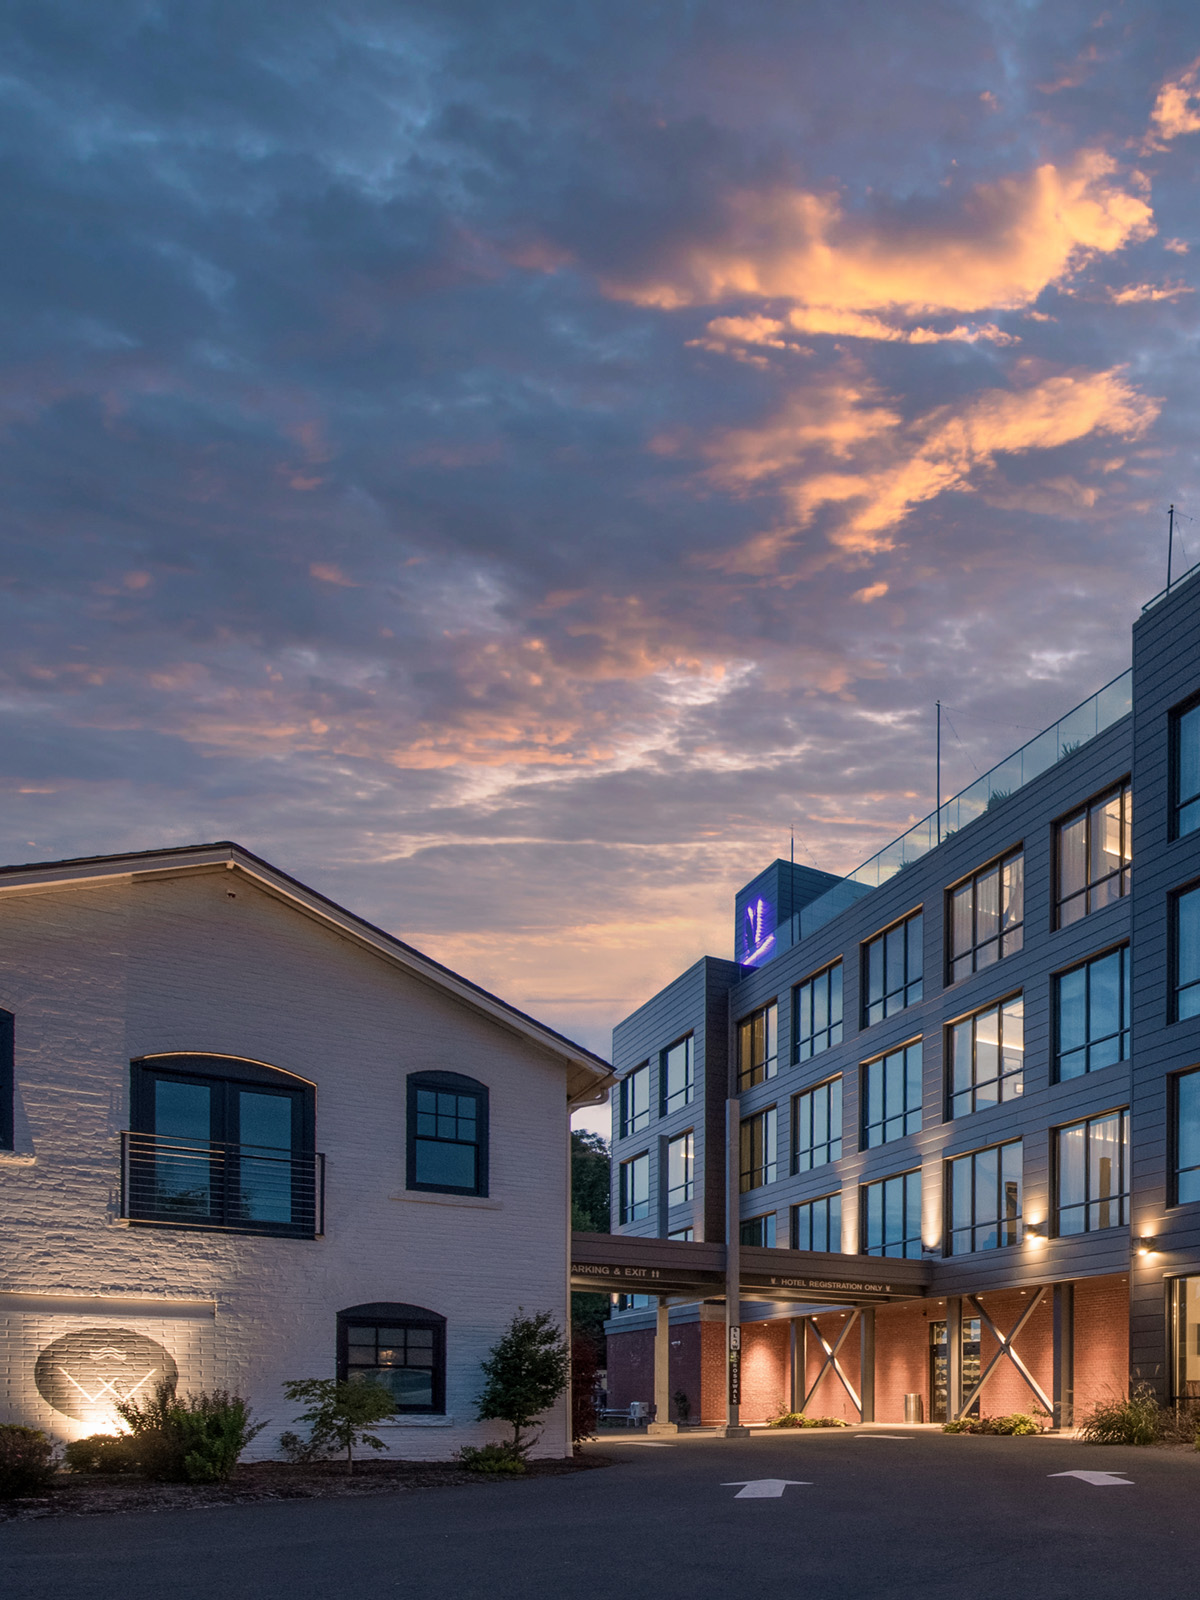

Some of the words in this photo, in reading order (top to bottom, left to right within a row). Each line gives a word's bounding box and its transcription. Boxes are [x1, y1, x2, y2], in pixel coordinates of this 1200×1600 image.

[571, 1264, 610, 1274] ARKING
[613, 1267, 621, 1275] &
[624, 1268, 647, 1277] EXIT
[781, 1279, 806, 1287] HOTEL
[809, 1280, 862, 1290] REGISTRATION
[731, 1327, 739, 1349] SLOW
